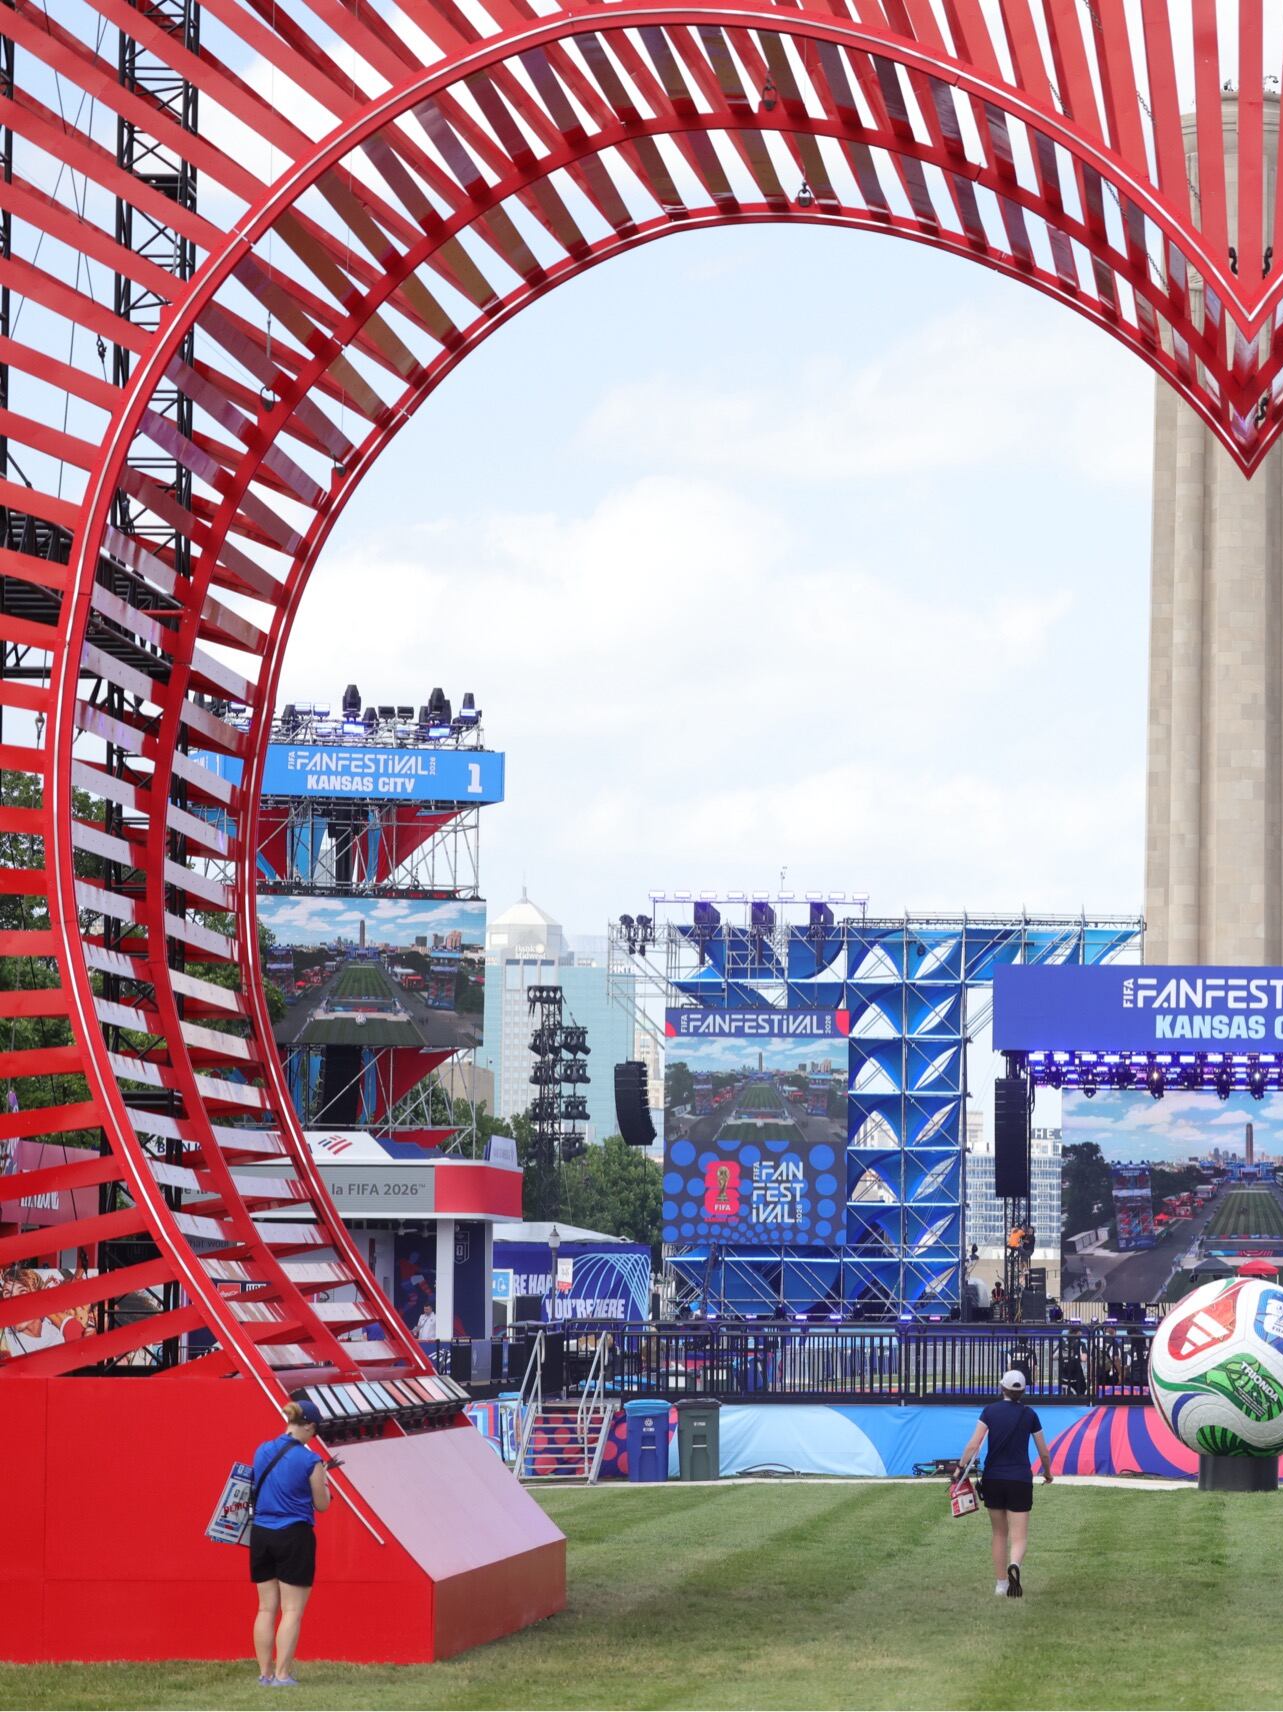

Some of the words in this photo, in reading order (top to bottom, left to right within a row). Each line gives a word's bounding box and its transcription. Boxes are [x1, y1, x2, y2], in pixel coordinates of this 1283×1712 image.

[287, 751, 296, 770] FIFA
[307, 774, 374, 792] KANSAS
[378, 776, 416, 793] CITY
[467, 763, 483, 793] 1
[1122, 978, 1134, 1007] FIFA
[680, 1014, 688, 1033] FIFA
[1155, 1015, 1266, 1039] KANSAS
[762, 1161, 804, 1181] FAN
[331, 1183, 344, 1195] la
[348, 1183, 380, 1195] FIFA
[752, 1183, 804, 1202] FEST
[595, 1298, 626, 1319] HERE
[1240, 1360, 1280, 1402] TRIONDA
